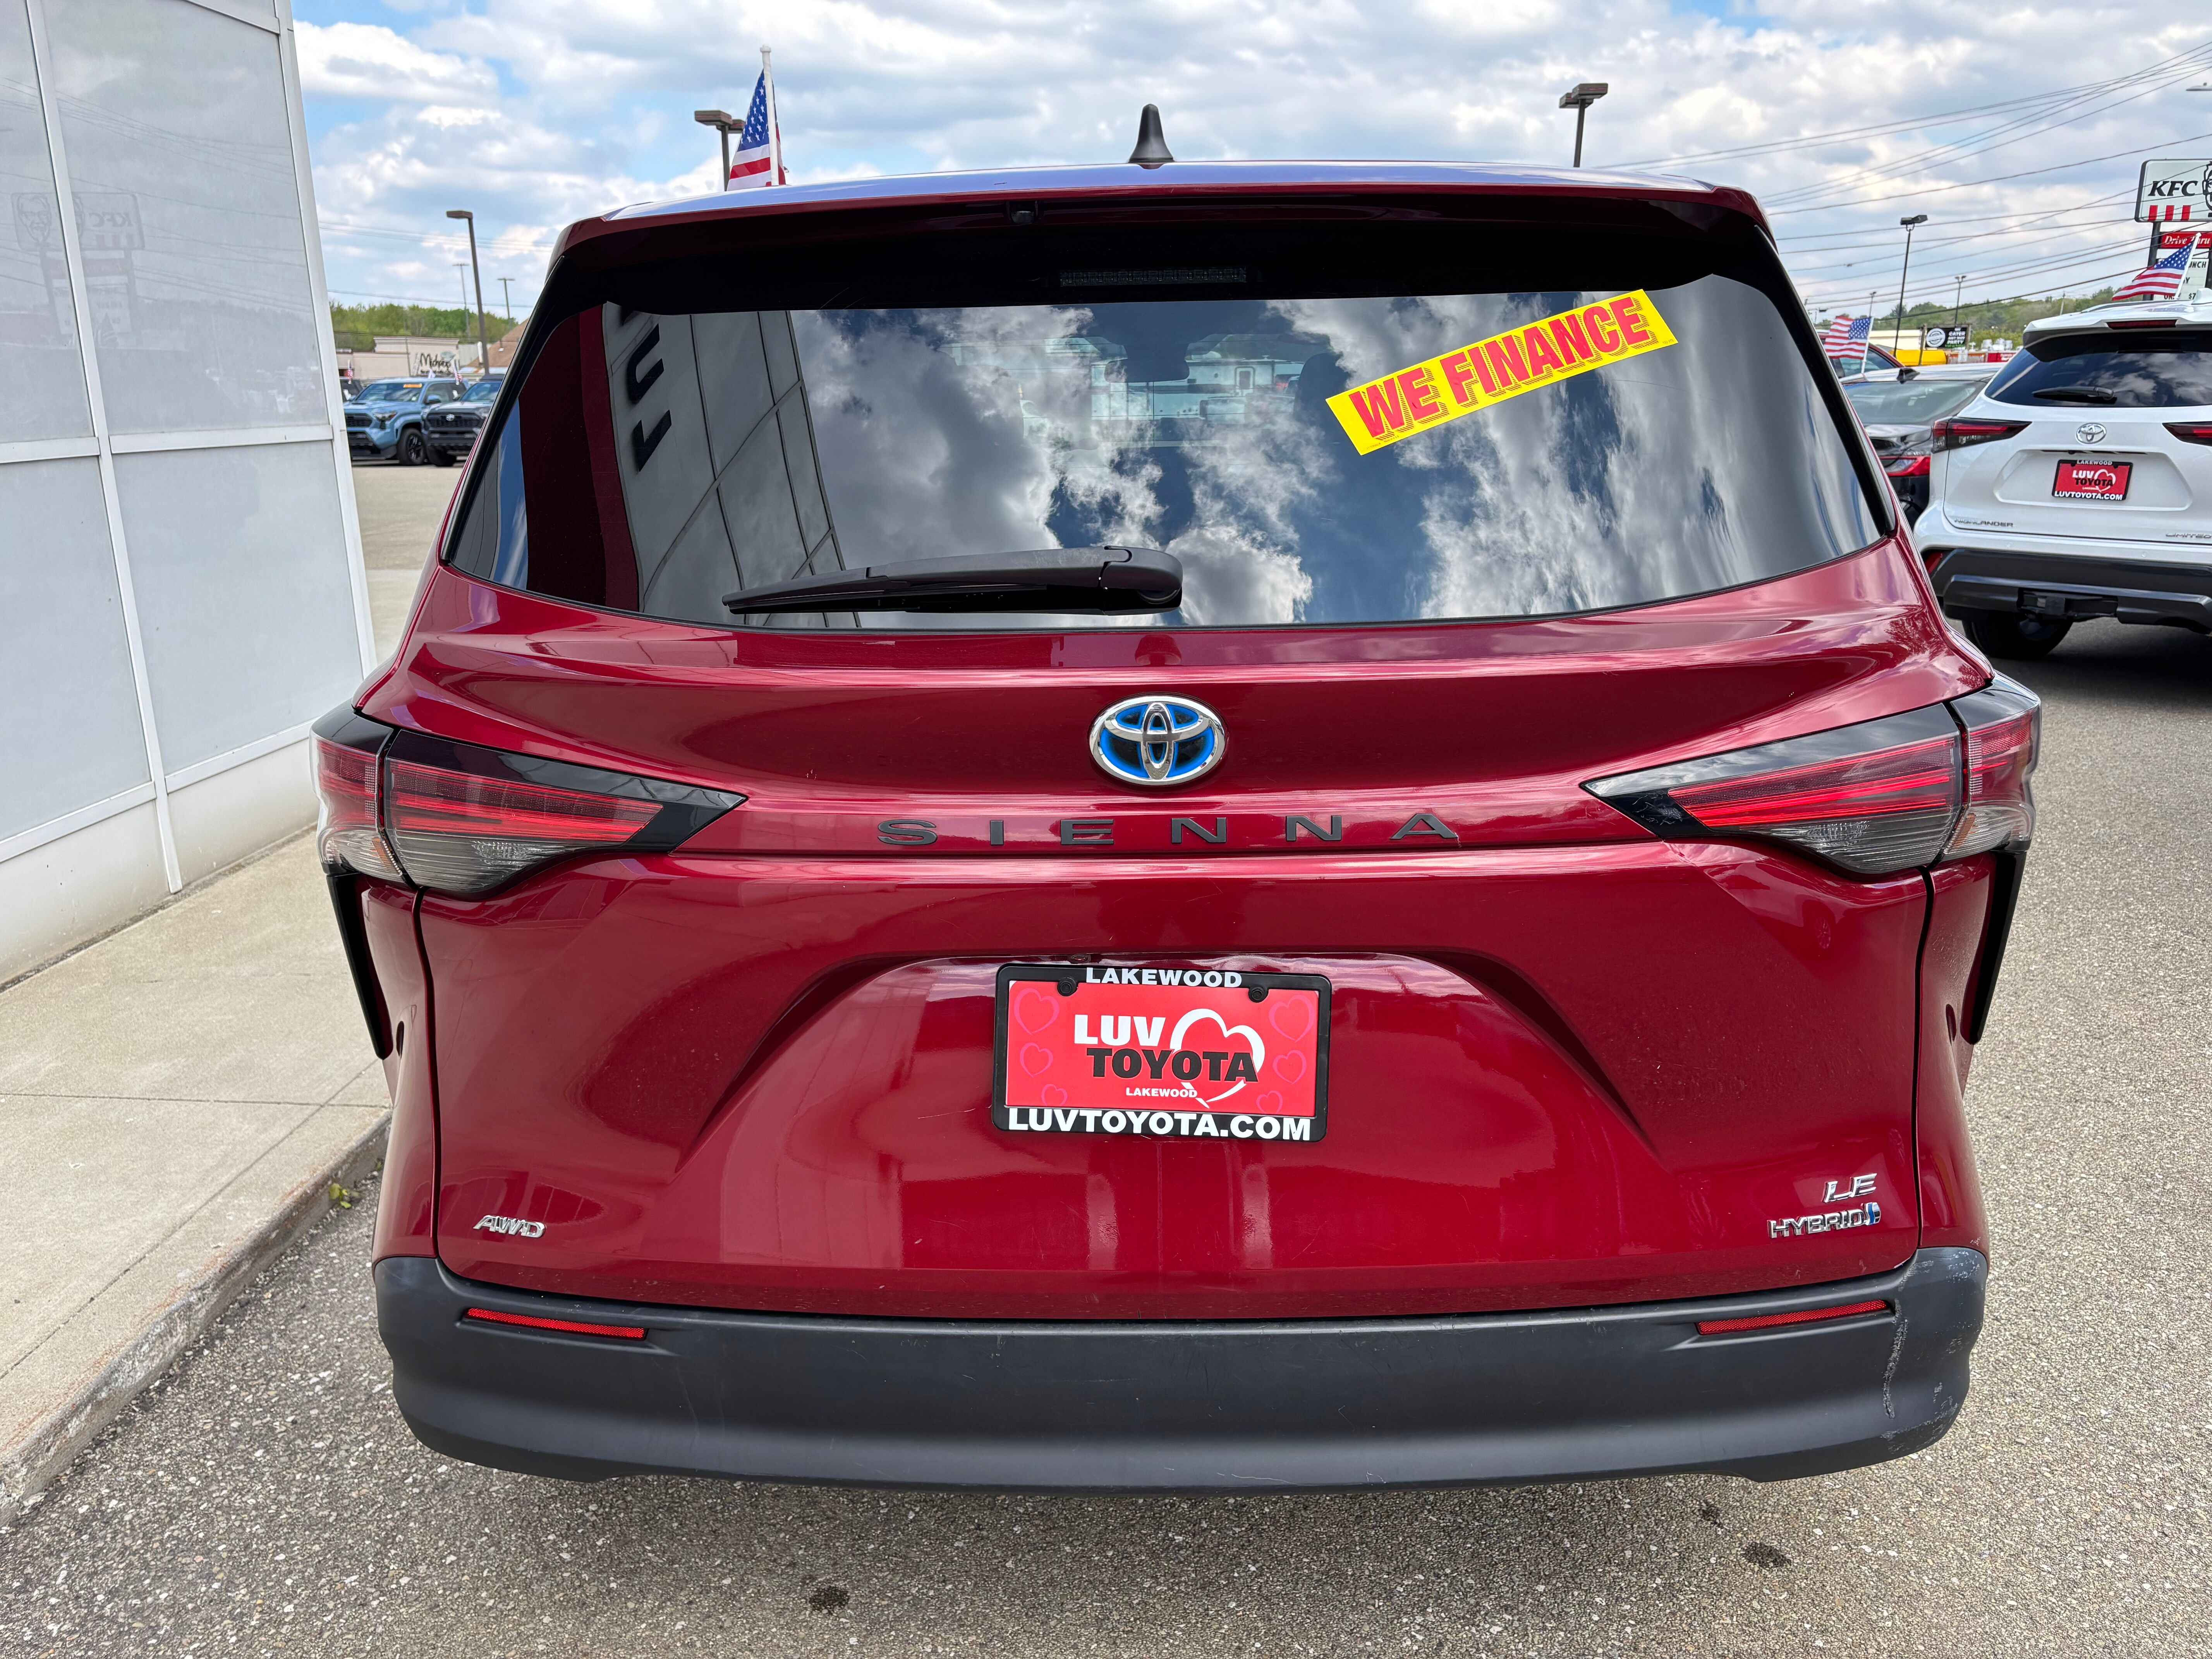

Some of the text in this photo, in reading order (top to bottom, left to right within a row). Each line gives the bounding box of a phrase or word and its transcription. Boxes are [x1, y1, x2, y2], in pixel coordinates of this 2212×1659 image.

[2148, 181, 2198, 197] KFC
[2165, 235, 2187, 245] Drive
[1349, 297, 1659, 440] WE FINANCE
[2073, 470, 2094, 479] LUV
[2075, 478, 2113, 487] TOYOTA
[2054, 491, 2123, 500] LUVTOYOTA.COM
[878, 812, 1459, 846] SIENNA
[1086, 967, 1242, 988] LAKEWOOD
[1075, 1014, 1165, 1047] LUV
[1086, 1048, 1259, 1082] TOYOTA
[1125, 1087, 1197, 1098] LAKEWOOD
[1009, 1108, 1310, 1141] LUVTOYOTA.COM
[1822, 1173, 1877, 1203] LE
[473, 1214, 546, 1238] AWD
[1767, 1209, 1867, 1238] HYBRID
